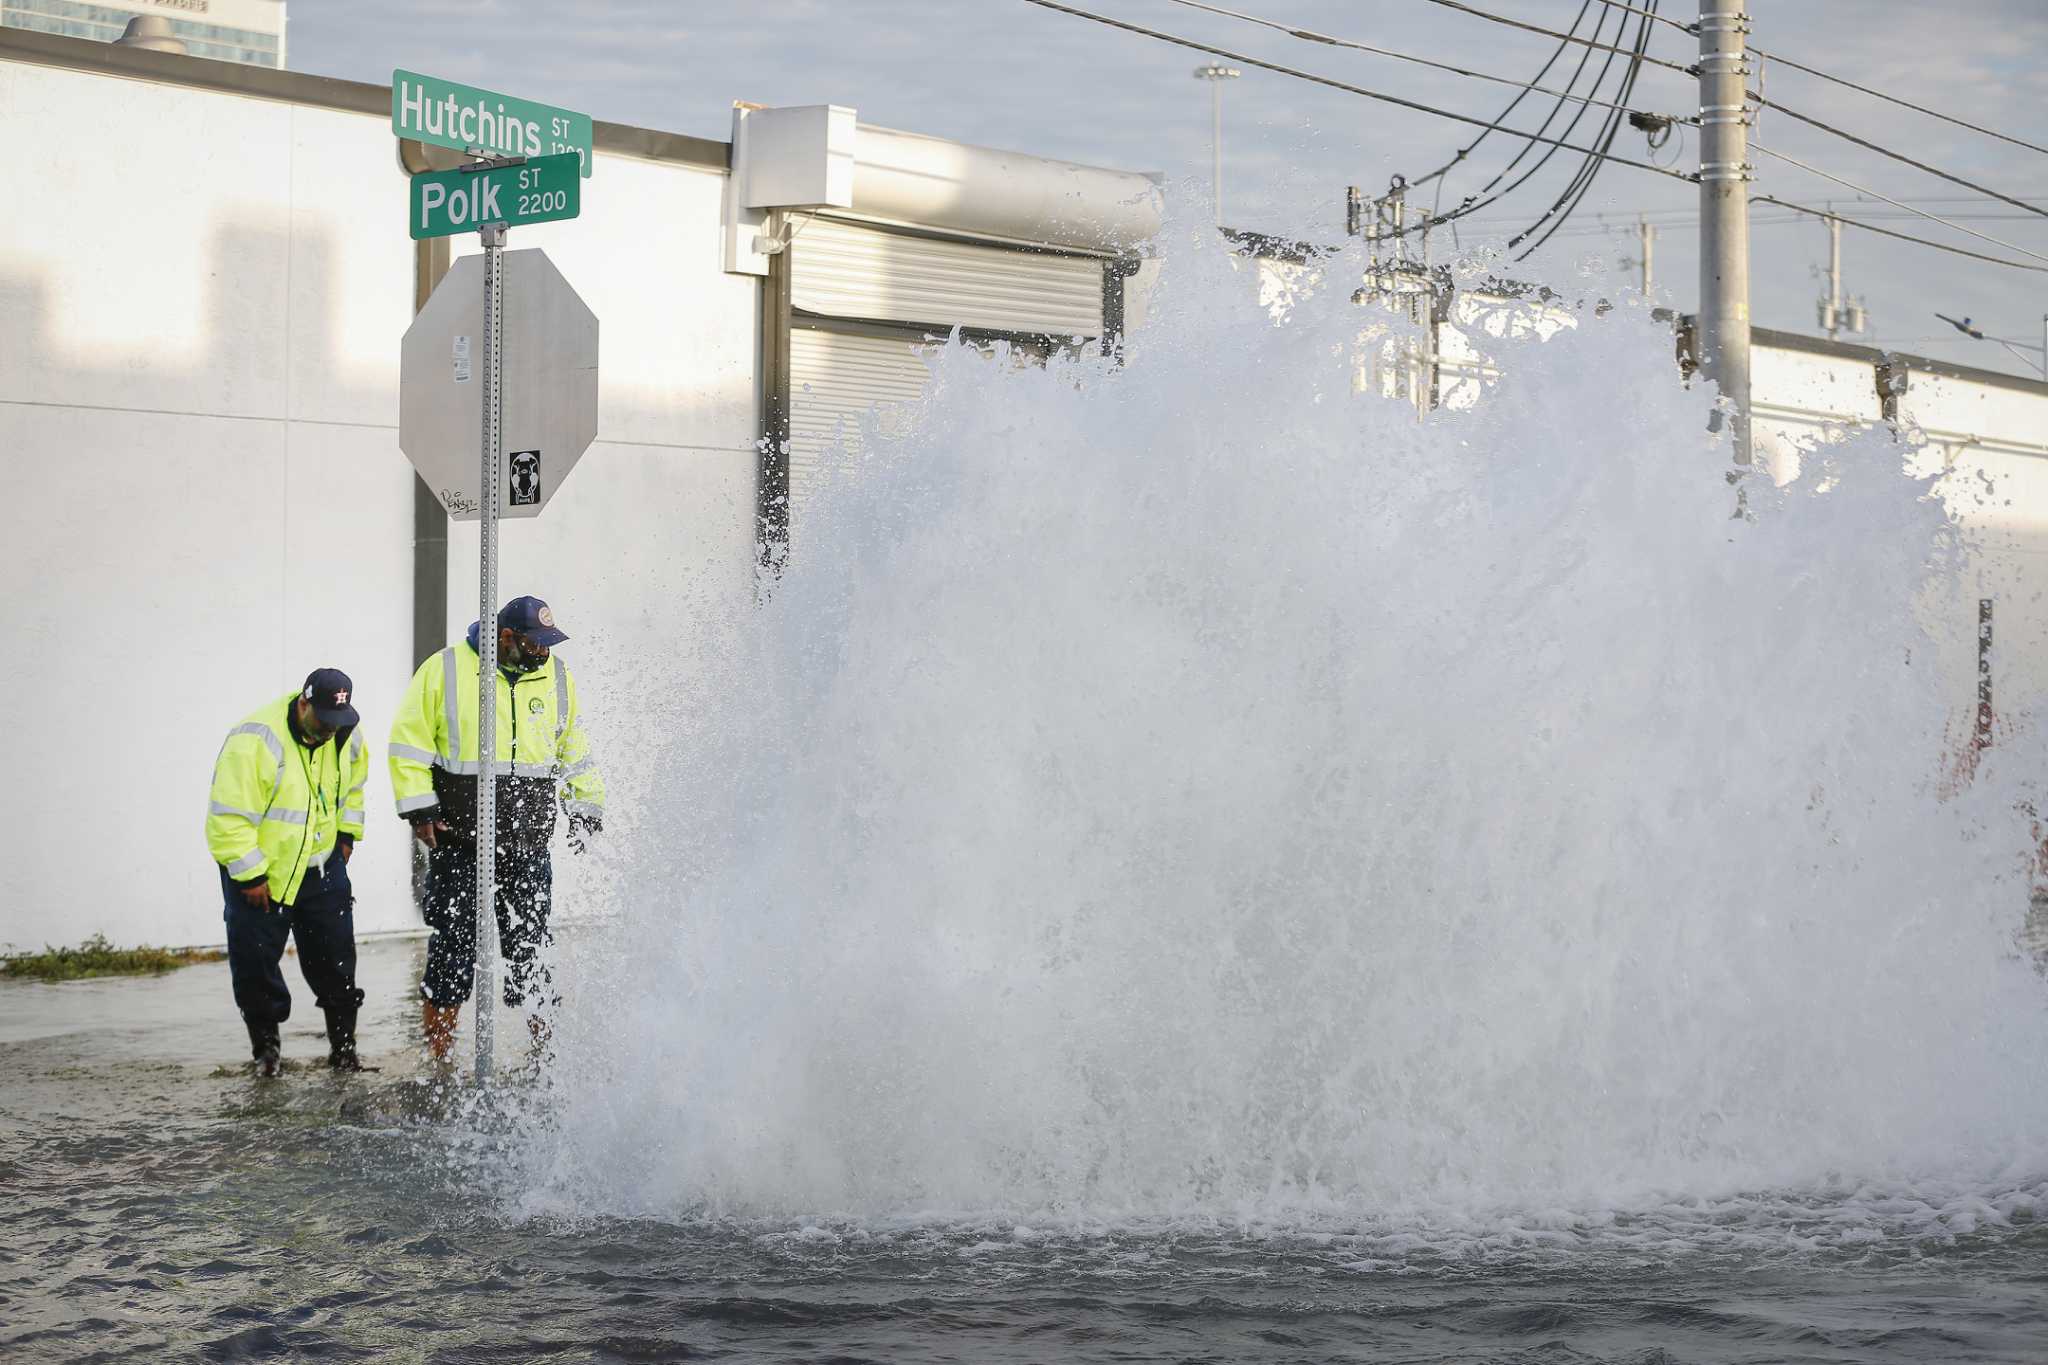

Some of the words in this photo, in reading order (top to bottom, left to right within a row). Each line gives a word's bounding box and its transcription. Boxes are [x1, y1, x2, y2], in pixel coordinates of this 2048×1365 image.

[401, 81, 542, 157] Hutchins
[552, 117, 570, 139] ST
[519, 168, 541, 190] ST
[422, 176, 503, 229] Polk
[518, 190, 567, 216] 2200
